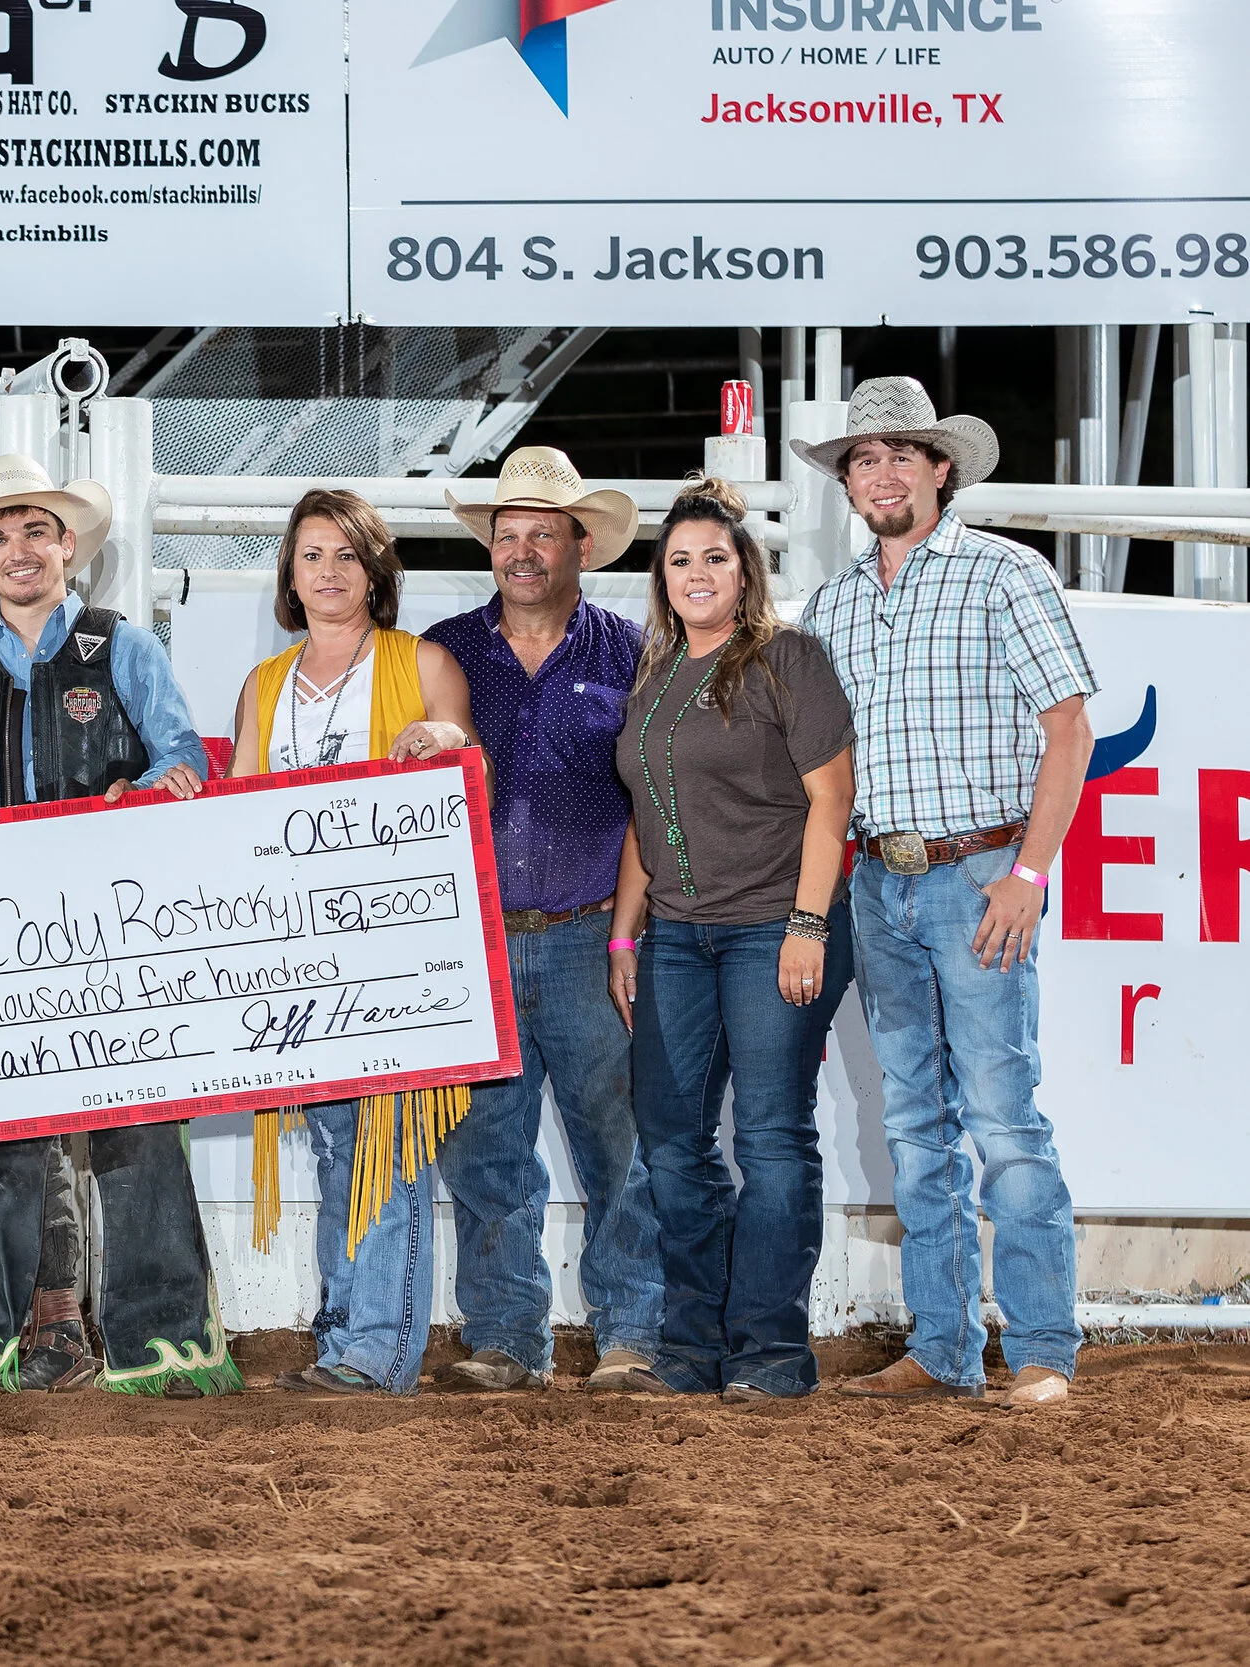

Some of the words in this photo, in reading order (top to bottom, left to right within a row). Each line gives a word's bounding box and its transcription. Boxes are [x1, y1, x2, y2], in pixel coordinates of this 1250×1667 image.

[710, 0, 1042, 31] INSURANCE
[712, 47, 775, 65] AUTO
[800, 47, 868, 65] HOME
[895, 47, 941, 65] LIFE
[8, 90, 43, 116] HAT
[48, 90, 78, 116] CO.
[106, 94, 218, 113] STACKIN
[225, 94, 310, 113] BUCKS
[701, 93, 942, 128] Jacksonville,
[953, 93, 1005, 123] TX
[385, 236, 504, 281] 804
[522, 236, 574, 281] S.
[594, 235, 825, 281] Jackson
[916, 233, 1250, 281] 903.586.98
[329, 798, 357, 809] 1234
[253, 844, 284, 857] Date:
[424, 960, 464, 973] Dollars
[137, 964, 208, 1006] five
[205, 953, 340, 994] hundred
[70, 1024, 190, 1067] Meier
[362, 1057, 401, 1072] 1234
